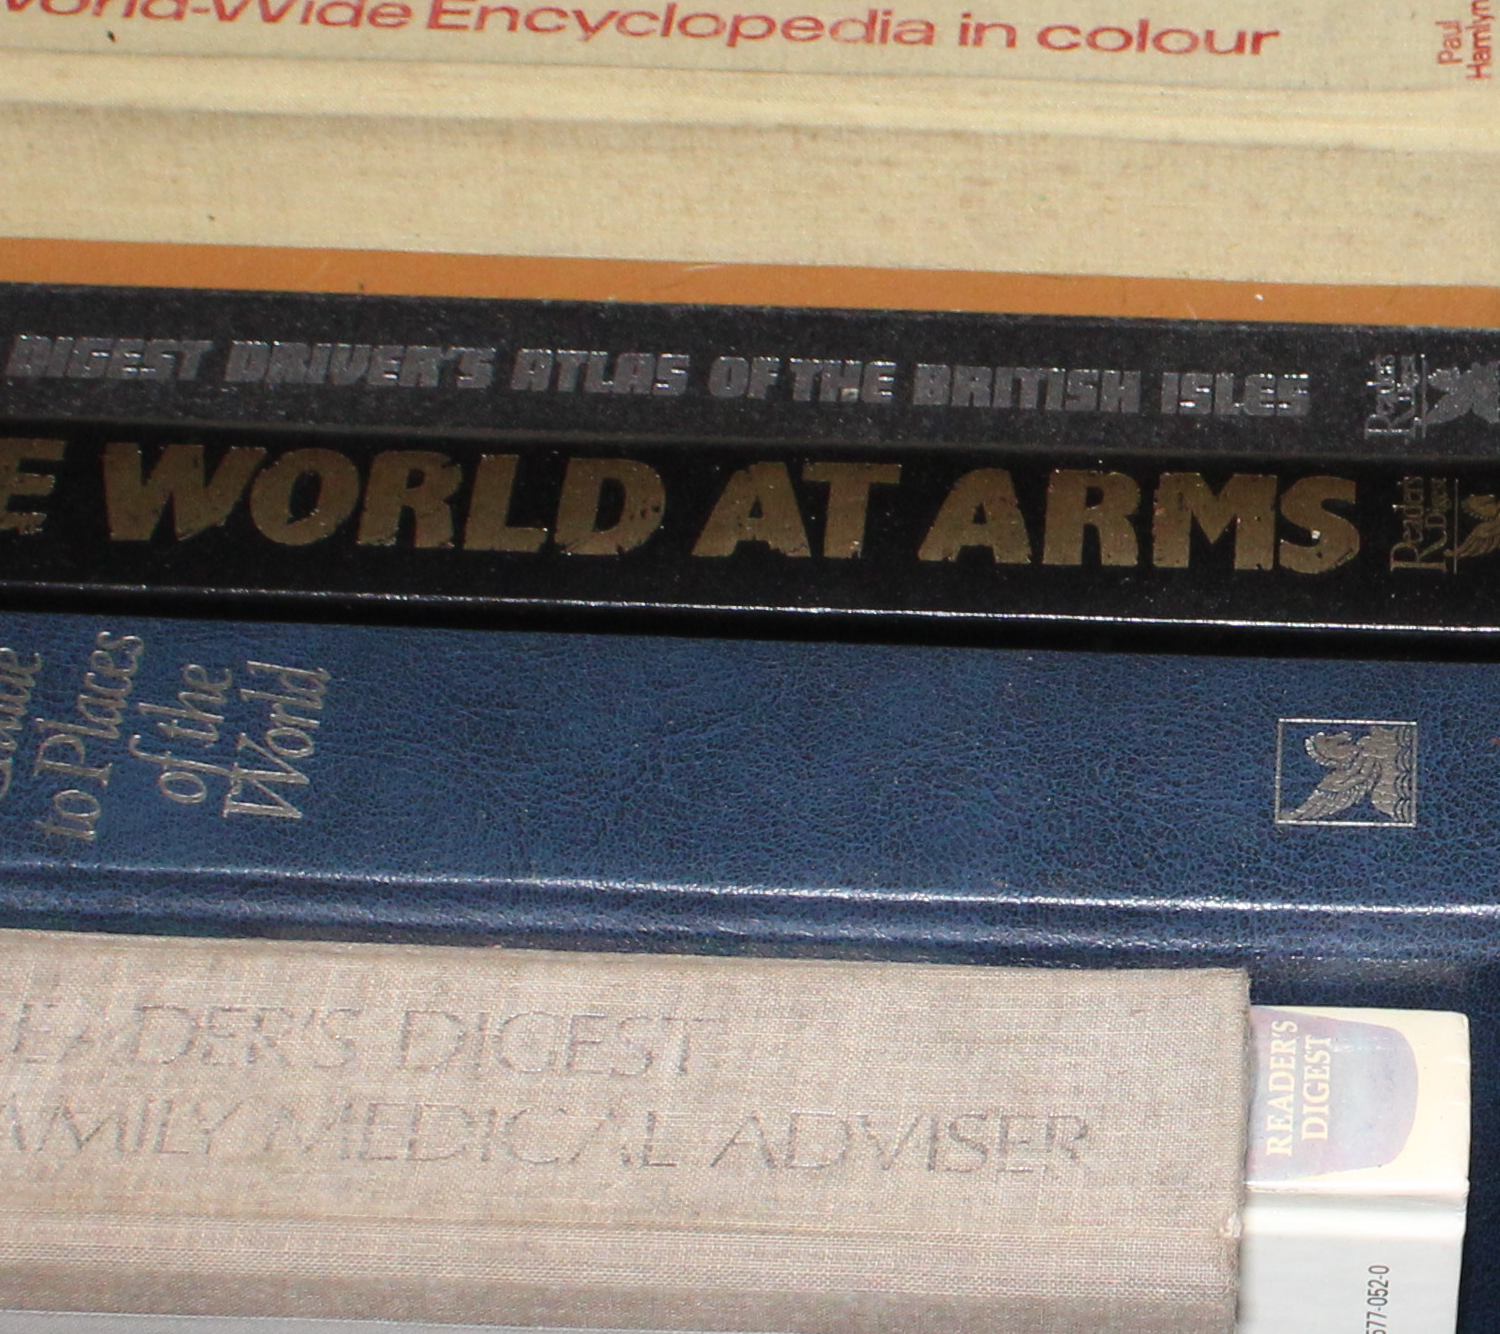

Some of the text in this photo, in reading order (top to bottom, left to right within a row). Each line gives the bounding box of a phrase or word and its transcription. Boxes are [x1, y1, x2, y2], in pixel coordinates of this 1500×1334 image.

[957, 12, 1017, 49] in
[1036, 19, 1282, 56] colour
[1435, 18, 1466, 66] Paul
[3, 334, 216, 382] DIGEST
[222, 338, 500, 391] DRIVER'S
[509, 348, 690, 397] ATLAS
[709, 356, 781, 400] OF
[788, 359, 899, 405] THE
[911, 363, 1145, 415] BRITISH
[1157, 371, 1311, 418] ISLES
[101, 441, 666, 558] WORLD
[690, 459, 902, 561] AT
[916, 468, 1362, 575] ARMS
[32, 630, 145, 843] to Places
[128, 664, 232, 804] of the
[221, 660, 332, 819] World
[395, 1009, 724, 1079] DIGEST
[1264, 1018, 1300, 1157] READER'S
[1301, 1034, 1333, 1142] DIGEST
[278, 1099, 681, 1170] MEDICAL
[709, 1109, 1095, 1174] ADVISER
